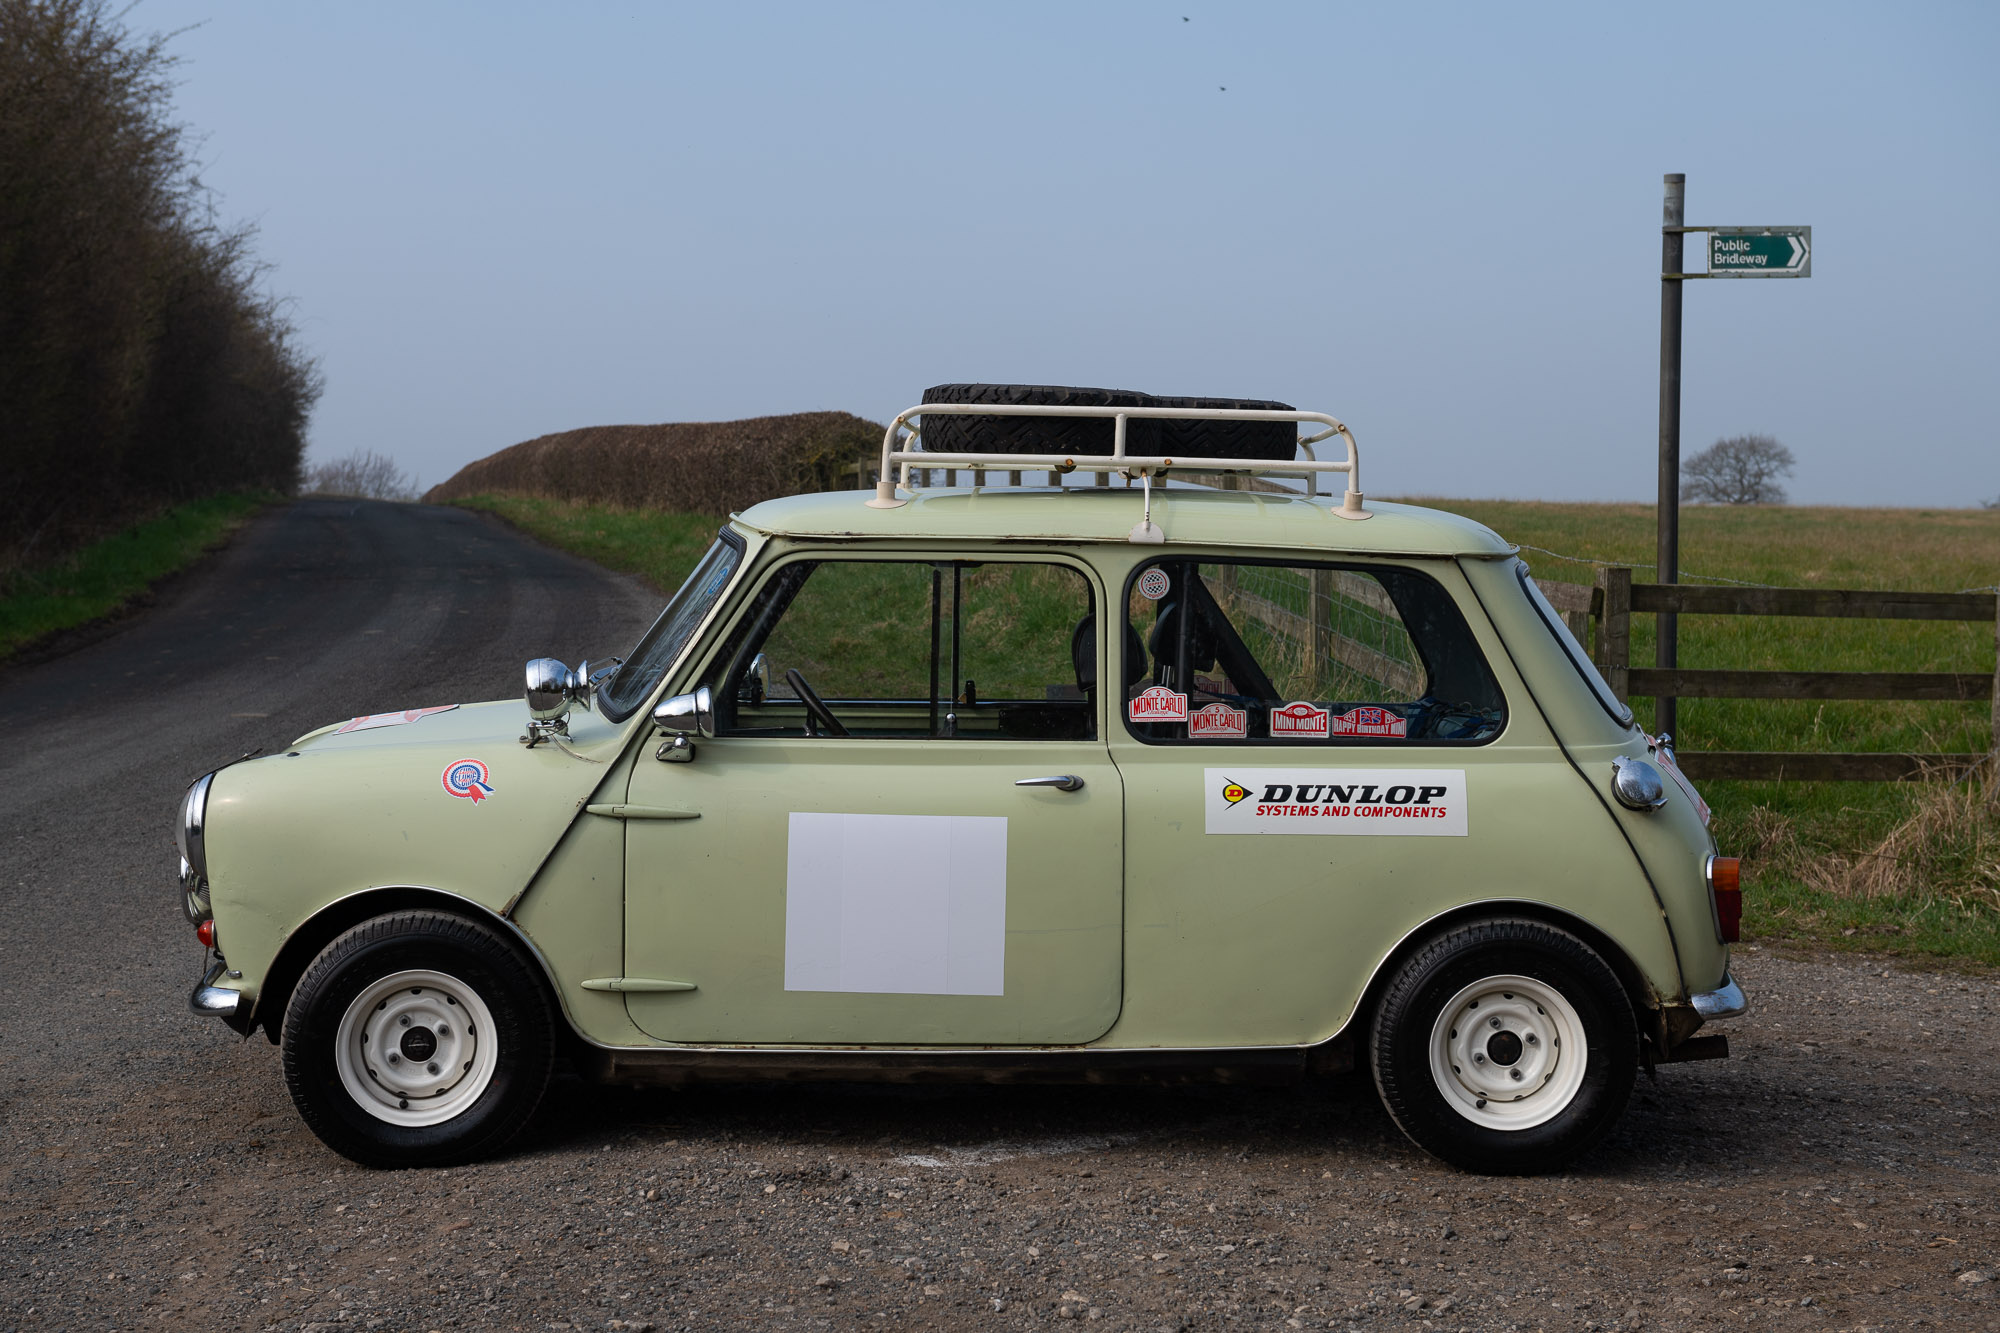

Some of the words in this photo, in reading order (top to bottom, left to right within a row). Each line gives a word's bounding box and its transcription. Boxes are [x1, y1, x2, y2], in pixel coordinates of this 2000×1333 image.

[1714, 240, 1751, 251] Public
[1714, 253, 1768, 266] Bridleway
[1133, 697, 1159, 716] MONTE
[1160, 697, 1183, 715] CARLO
[1192, 714, 1218, 732] MONTE
[1219, 714, 1241, 731] CARLO
[1275, 711, 1295, 730] MINI
[1296, 712, 1325, 731] MONTE
[1333, 718, 1355, 733] HAPPY
[1357, 724, 1389, 734] BIRTHDAY
[1390, 720, 1405, 735] MINI
[1227, 789, 1242, 797] D
[1258, 784, 1447, 805] DUNLOP
[1255, 805, 1319, 817] SYSTEMS
[1321, 805, 1350, 817] AND
[1353, 806, 1447, 818] COMPONENTS
